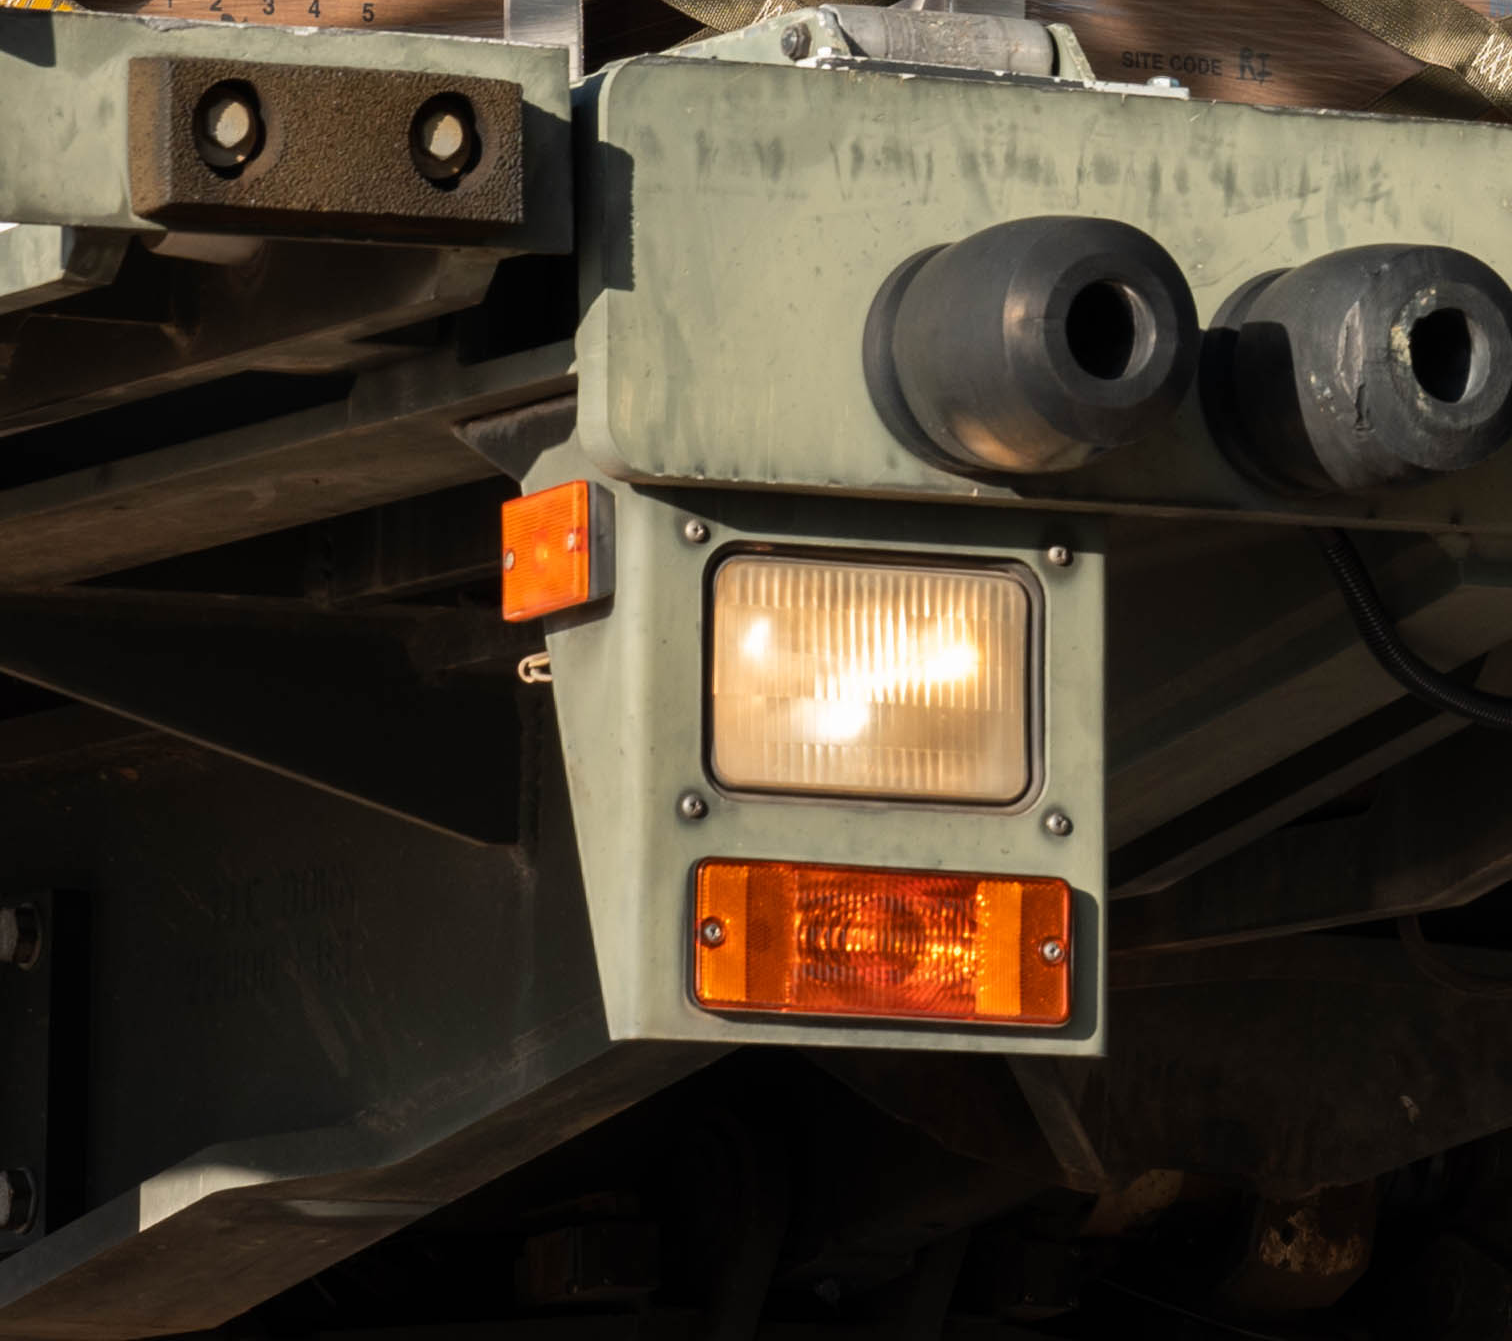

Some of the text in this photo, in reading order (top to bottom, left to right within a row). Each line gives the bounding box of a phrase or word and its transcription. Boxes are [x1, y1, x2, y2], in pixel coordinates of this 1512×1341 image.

[362, 3, 375, 23] 5
[1121, 50, 1223, 76] SITE CODE
